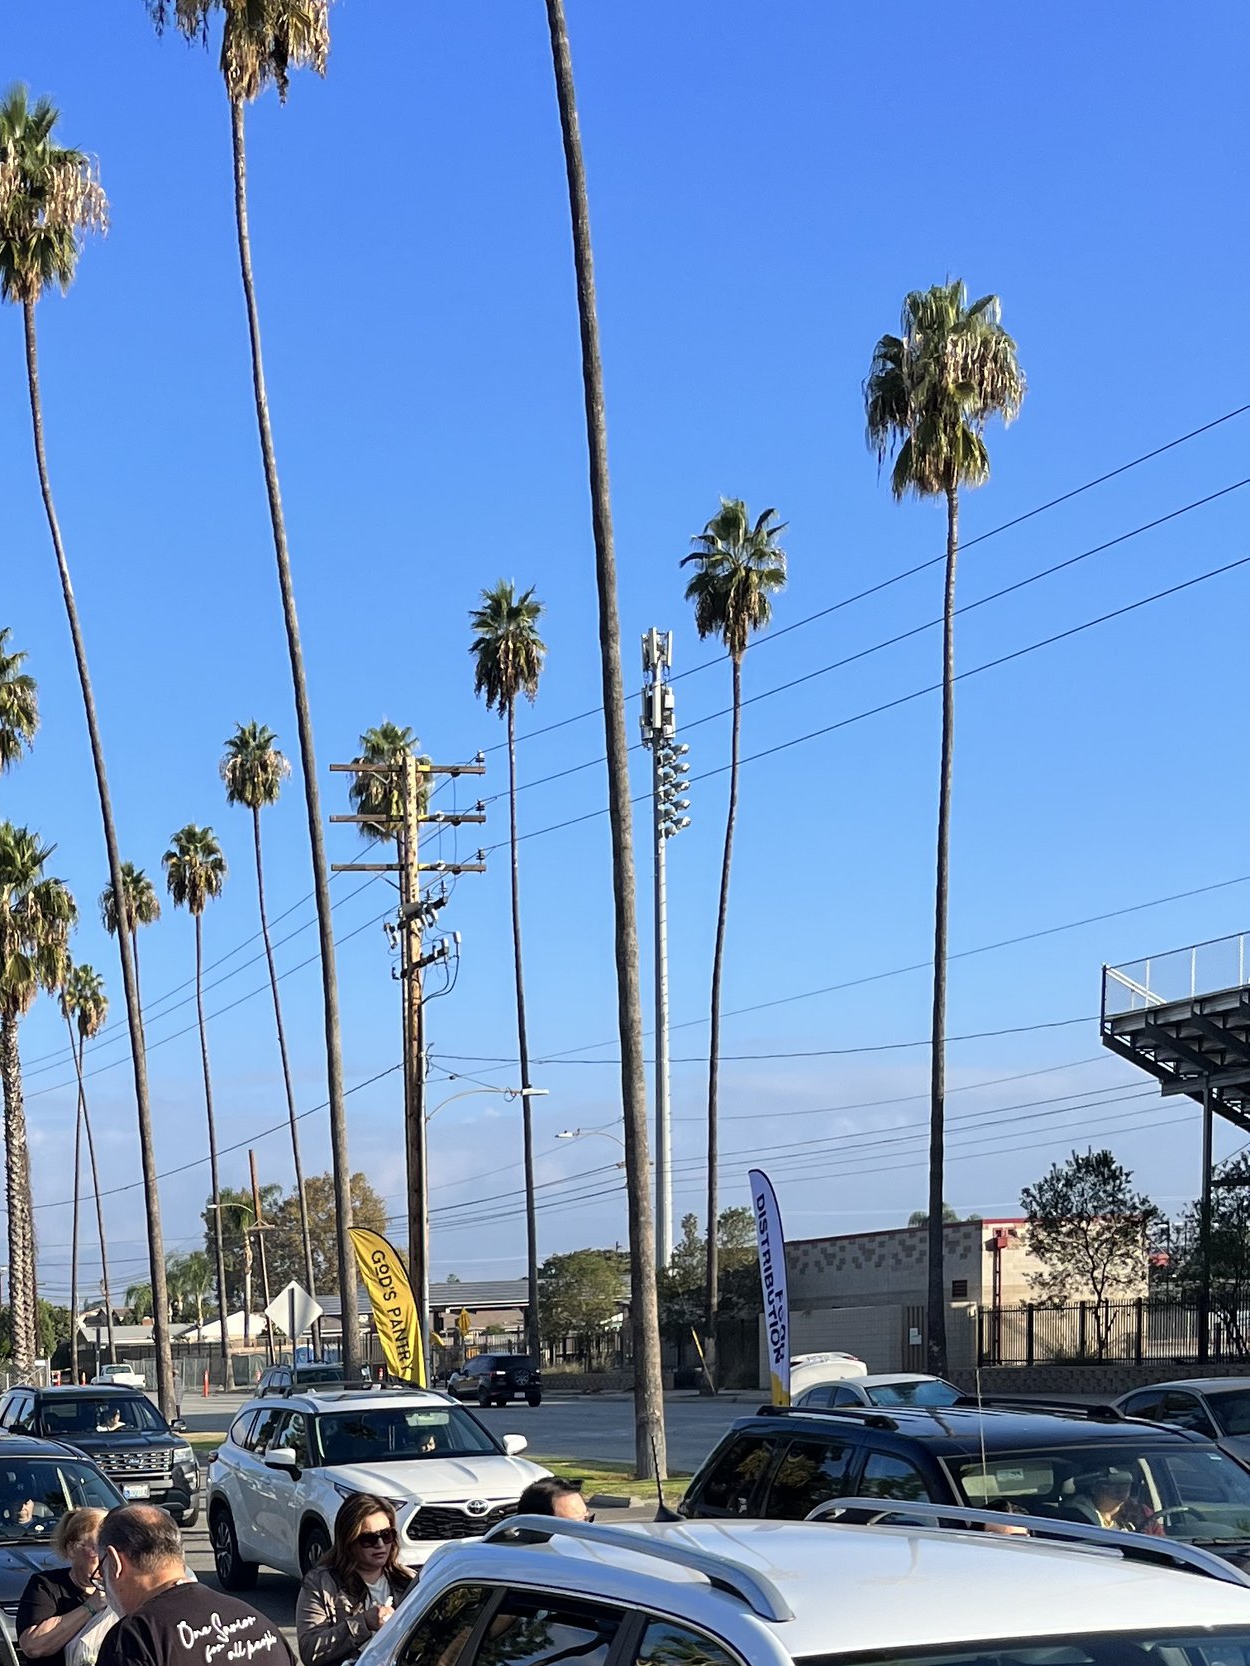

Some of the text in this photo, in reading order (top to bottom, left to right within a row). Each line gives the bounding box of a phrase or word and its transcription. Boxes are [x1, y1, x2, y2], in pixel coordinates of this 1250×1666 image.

[371, 1250, 414, 1375] GOD'S PANTRY
[756, 1193, 785, 1364] DISTRIBUTION
[176, 1619, 212, 1649] One
[205, 1630, 277, 1663] for all people
